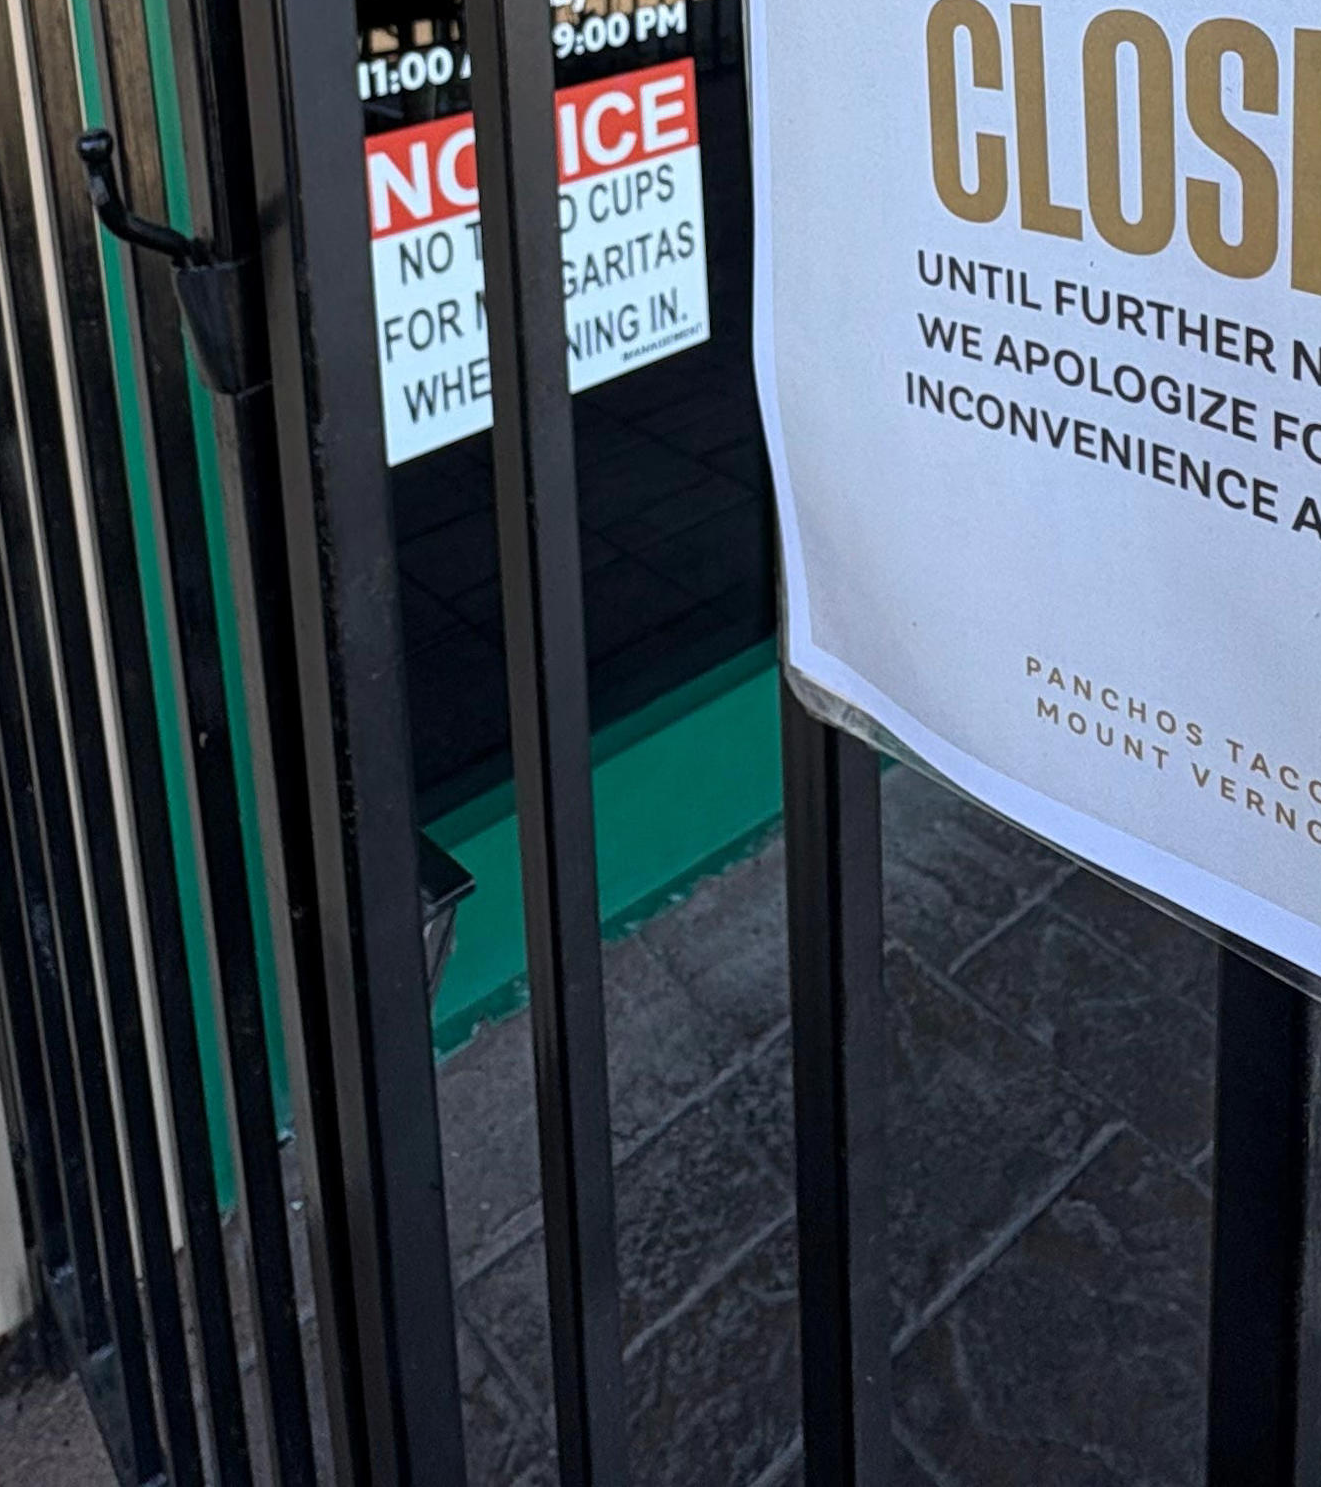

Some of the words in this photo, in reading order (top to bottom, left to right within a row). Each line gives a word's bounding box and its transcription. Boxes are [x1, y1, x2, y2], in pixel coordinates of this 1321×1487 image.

[553, 12, 630, 60] 9:00
[635, 0, 687, 42] PM
[366, 74, 690, 233] NOICE
[398, 231, 454, 286] NO
[588, 164, 675, 224] CUPS
[383, 299, 464, 363] FOR
[402, 358, 491, 425] WHE
[649, 286, 688, 333] IN.
[918, 250, 1042, 311] UNTIL
[1055, 280, 1276, 373] FURTHER
[918, 313, 982, 362] WE
[994, 335, 1257, 441] APOLOGIZE
[906, 372, 1278, 523] INCONVENIENCE
[1027, 656, 1203, 747] PANCHOS
[1037, 697, 1169, 770] MOUNT
